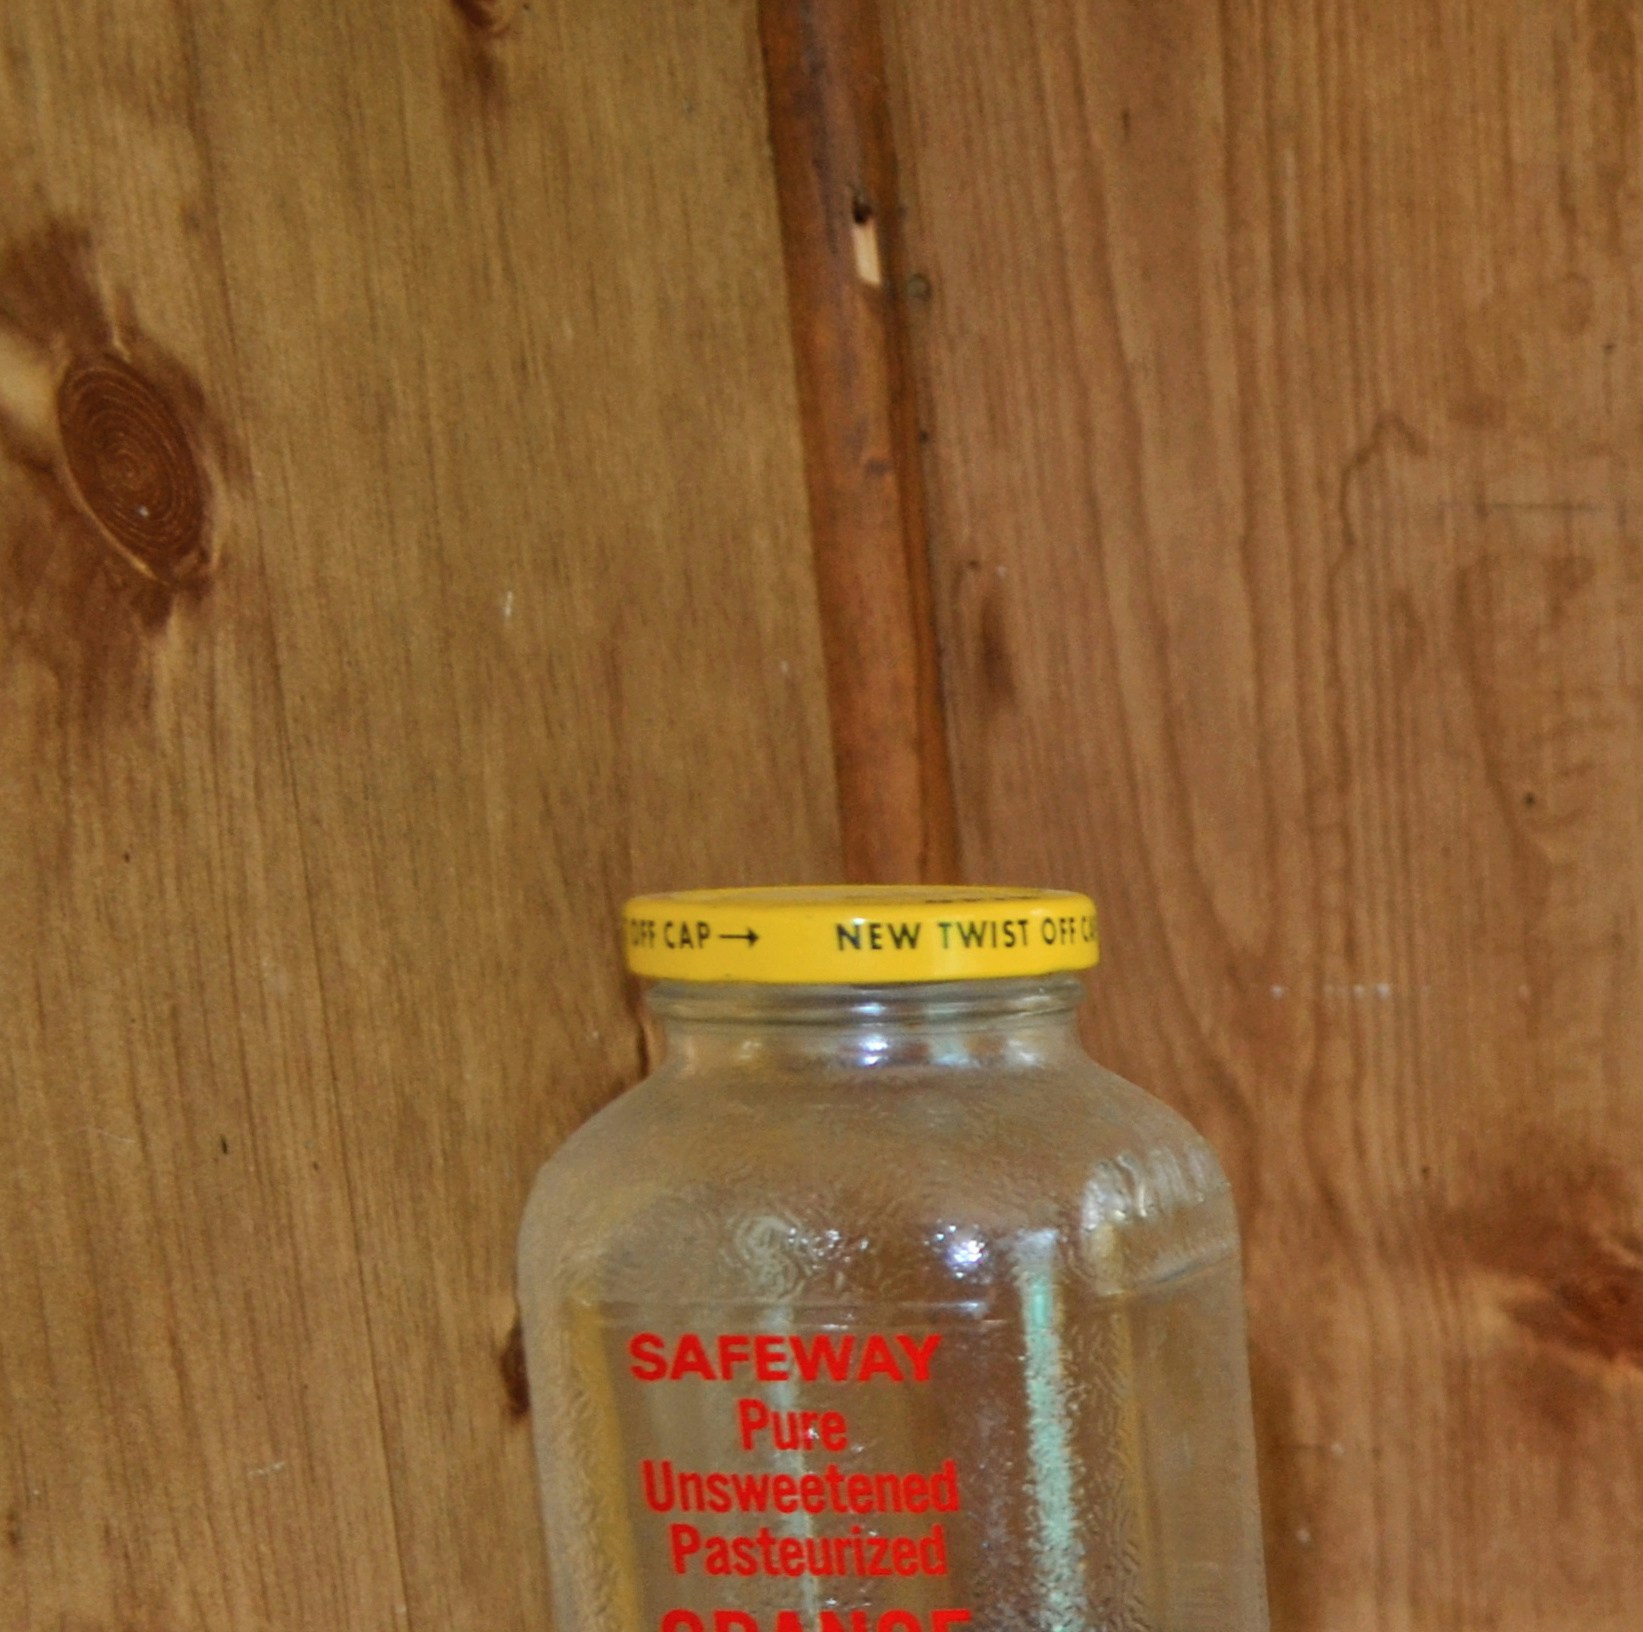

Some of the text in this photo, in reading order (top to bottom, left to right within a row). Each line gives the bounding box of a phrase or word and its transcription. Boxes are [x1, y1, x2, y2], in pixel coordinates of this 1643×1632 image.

[663, 920, 711, 950] CAP
[835, 922, 921, 951] NEW
[938, 918, 1029, 949] TWIST
[1041, 916, 1075, 946] OFF
[627, 1332, 943, 1384] SAFEWAY
[738, 1398, 849, 1453] Pure
[642, 1459, 961, 1515] Unsweetened
[668, 1523, 949, 1578] Pasteurized
